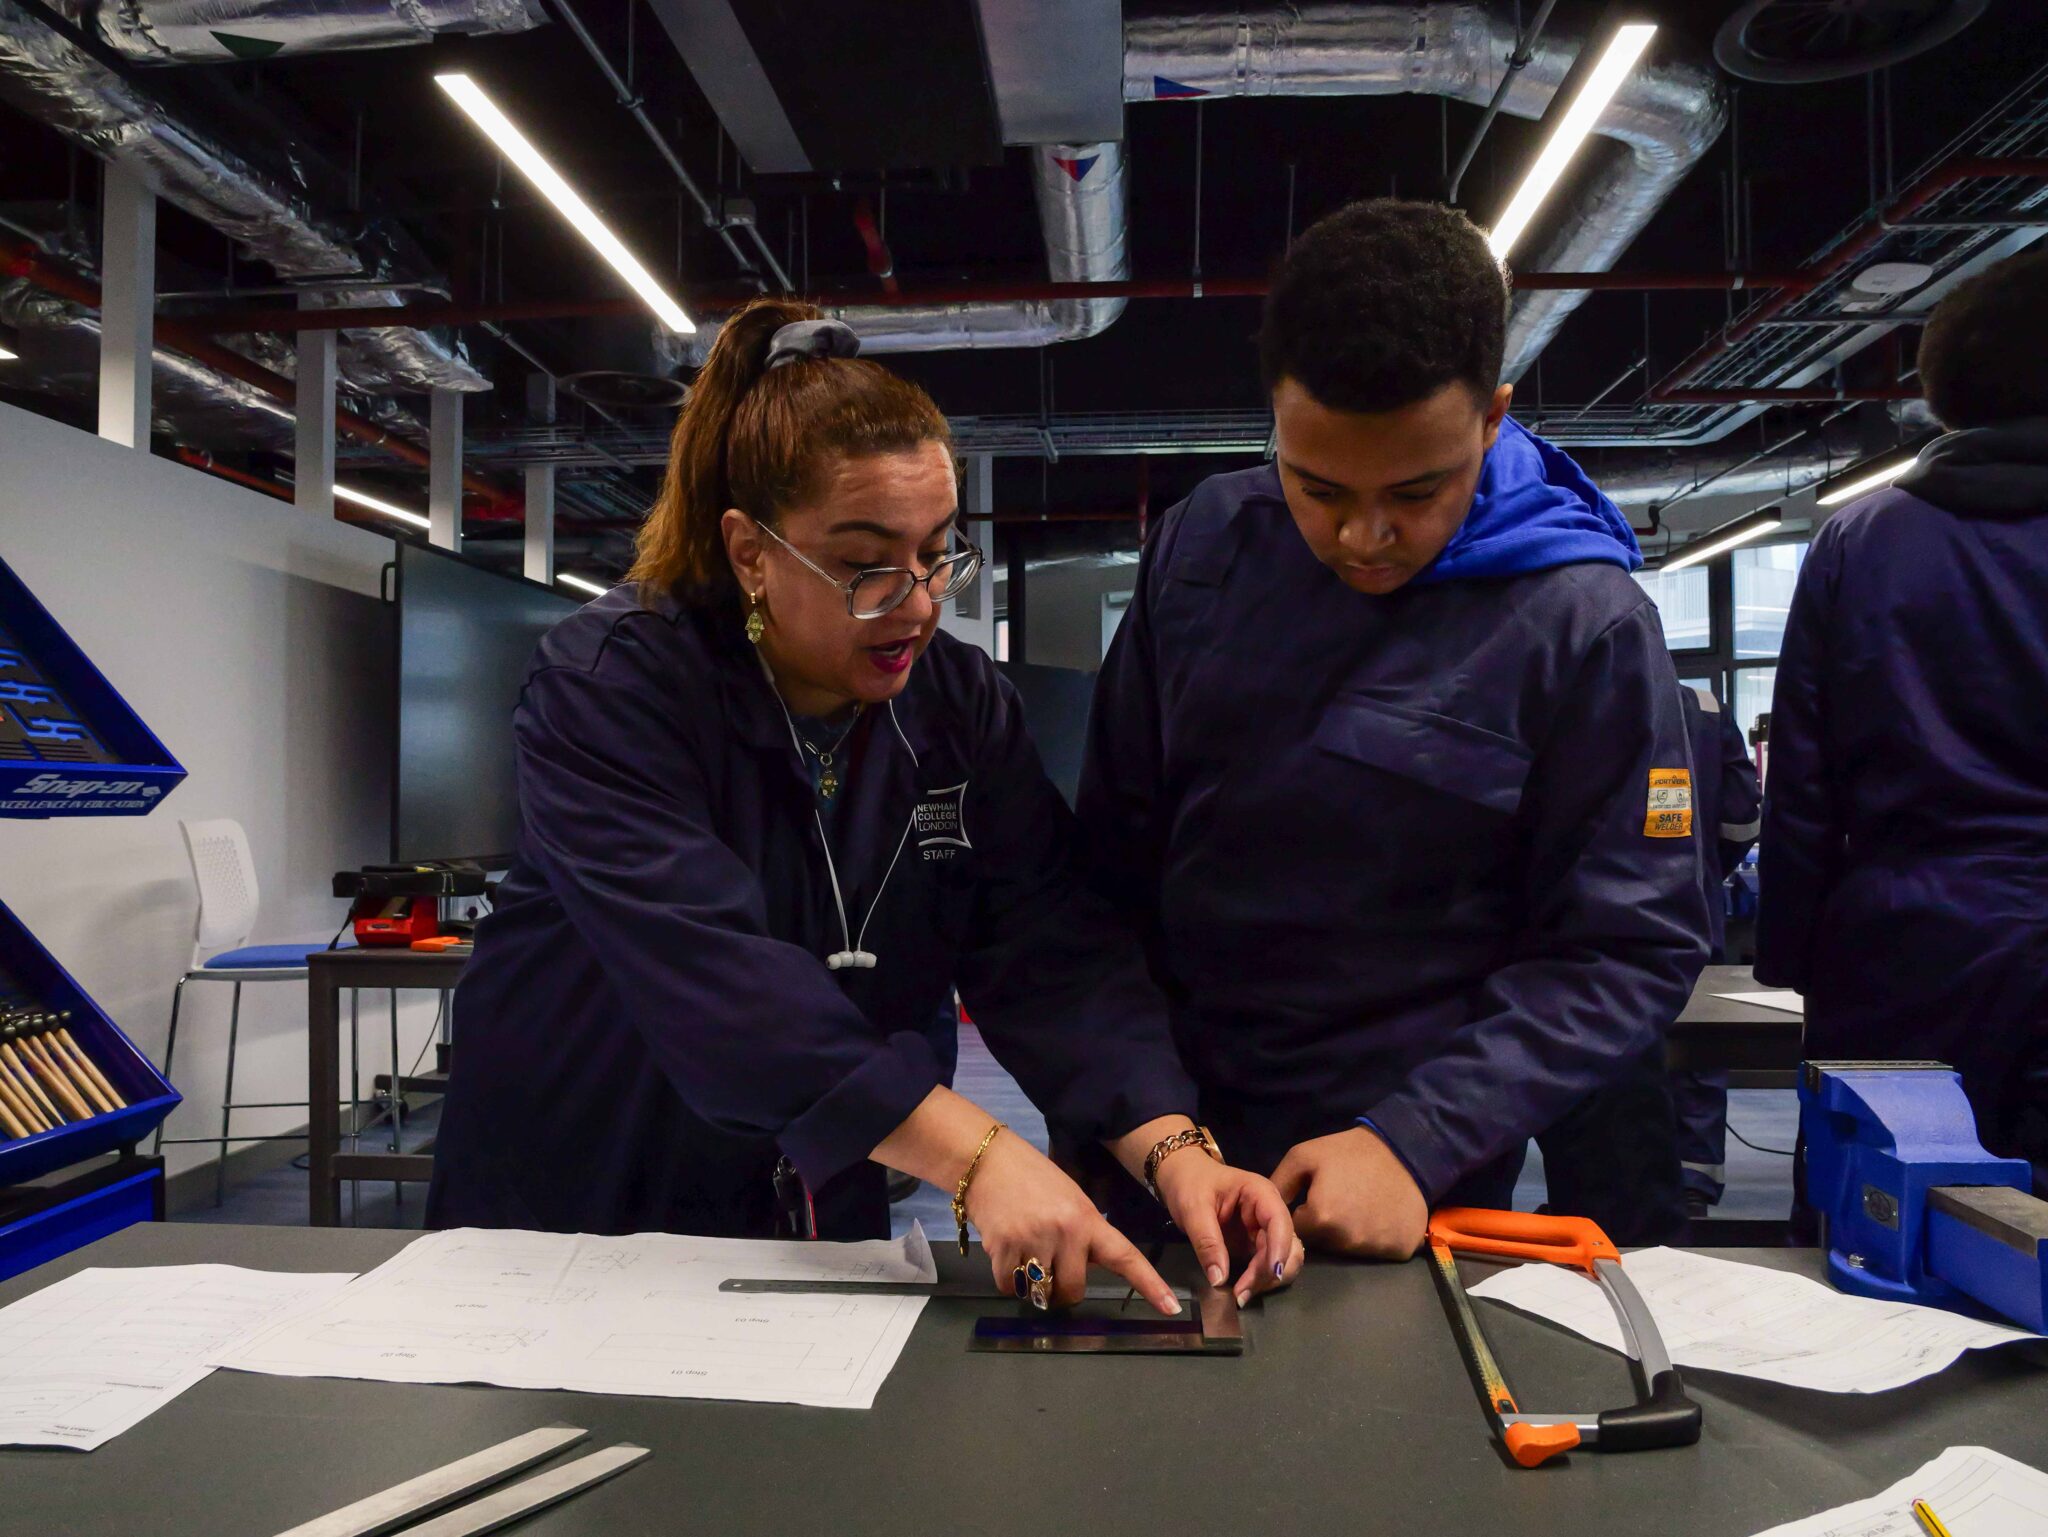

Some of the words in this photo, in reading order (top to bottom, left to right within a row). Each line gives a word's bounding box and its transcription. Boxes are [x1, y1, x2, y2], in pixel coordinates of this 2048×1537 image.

[13, 774, 144, 798] Snap-on
[0, 800, 69, 809] XCELLENCE
[83, 800, 145, 808] EDUCATION
[917, 803, 957, 812] NEWHAM
[918, 811, 957, 821] COLLEGE
[1659, 813, 1683, 822] SAFE
[919, 821, 958, 831] LONDON
[1655, 822, 1683, 831] WELDER
[923, 849, 956, 860] STAFF
